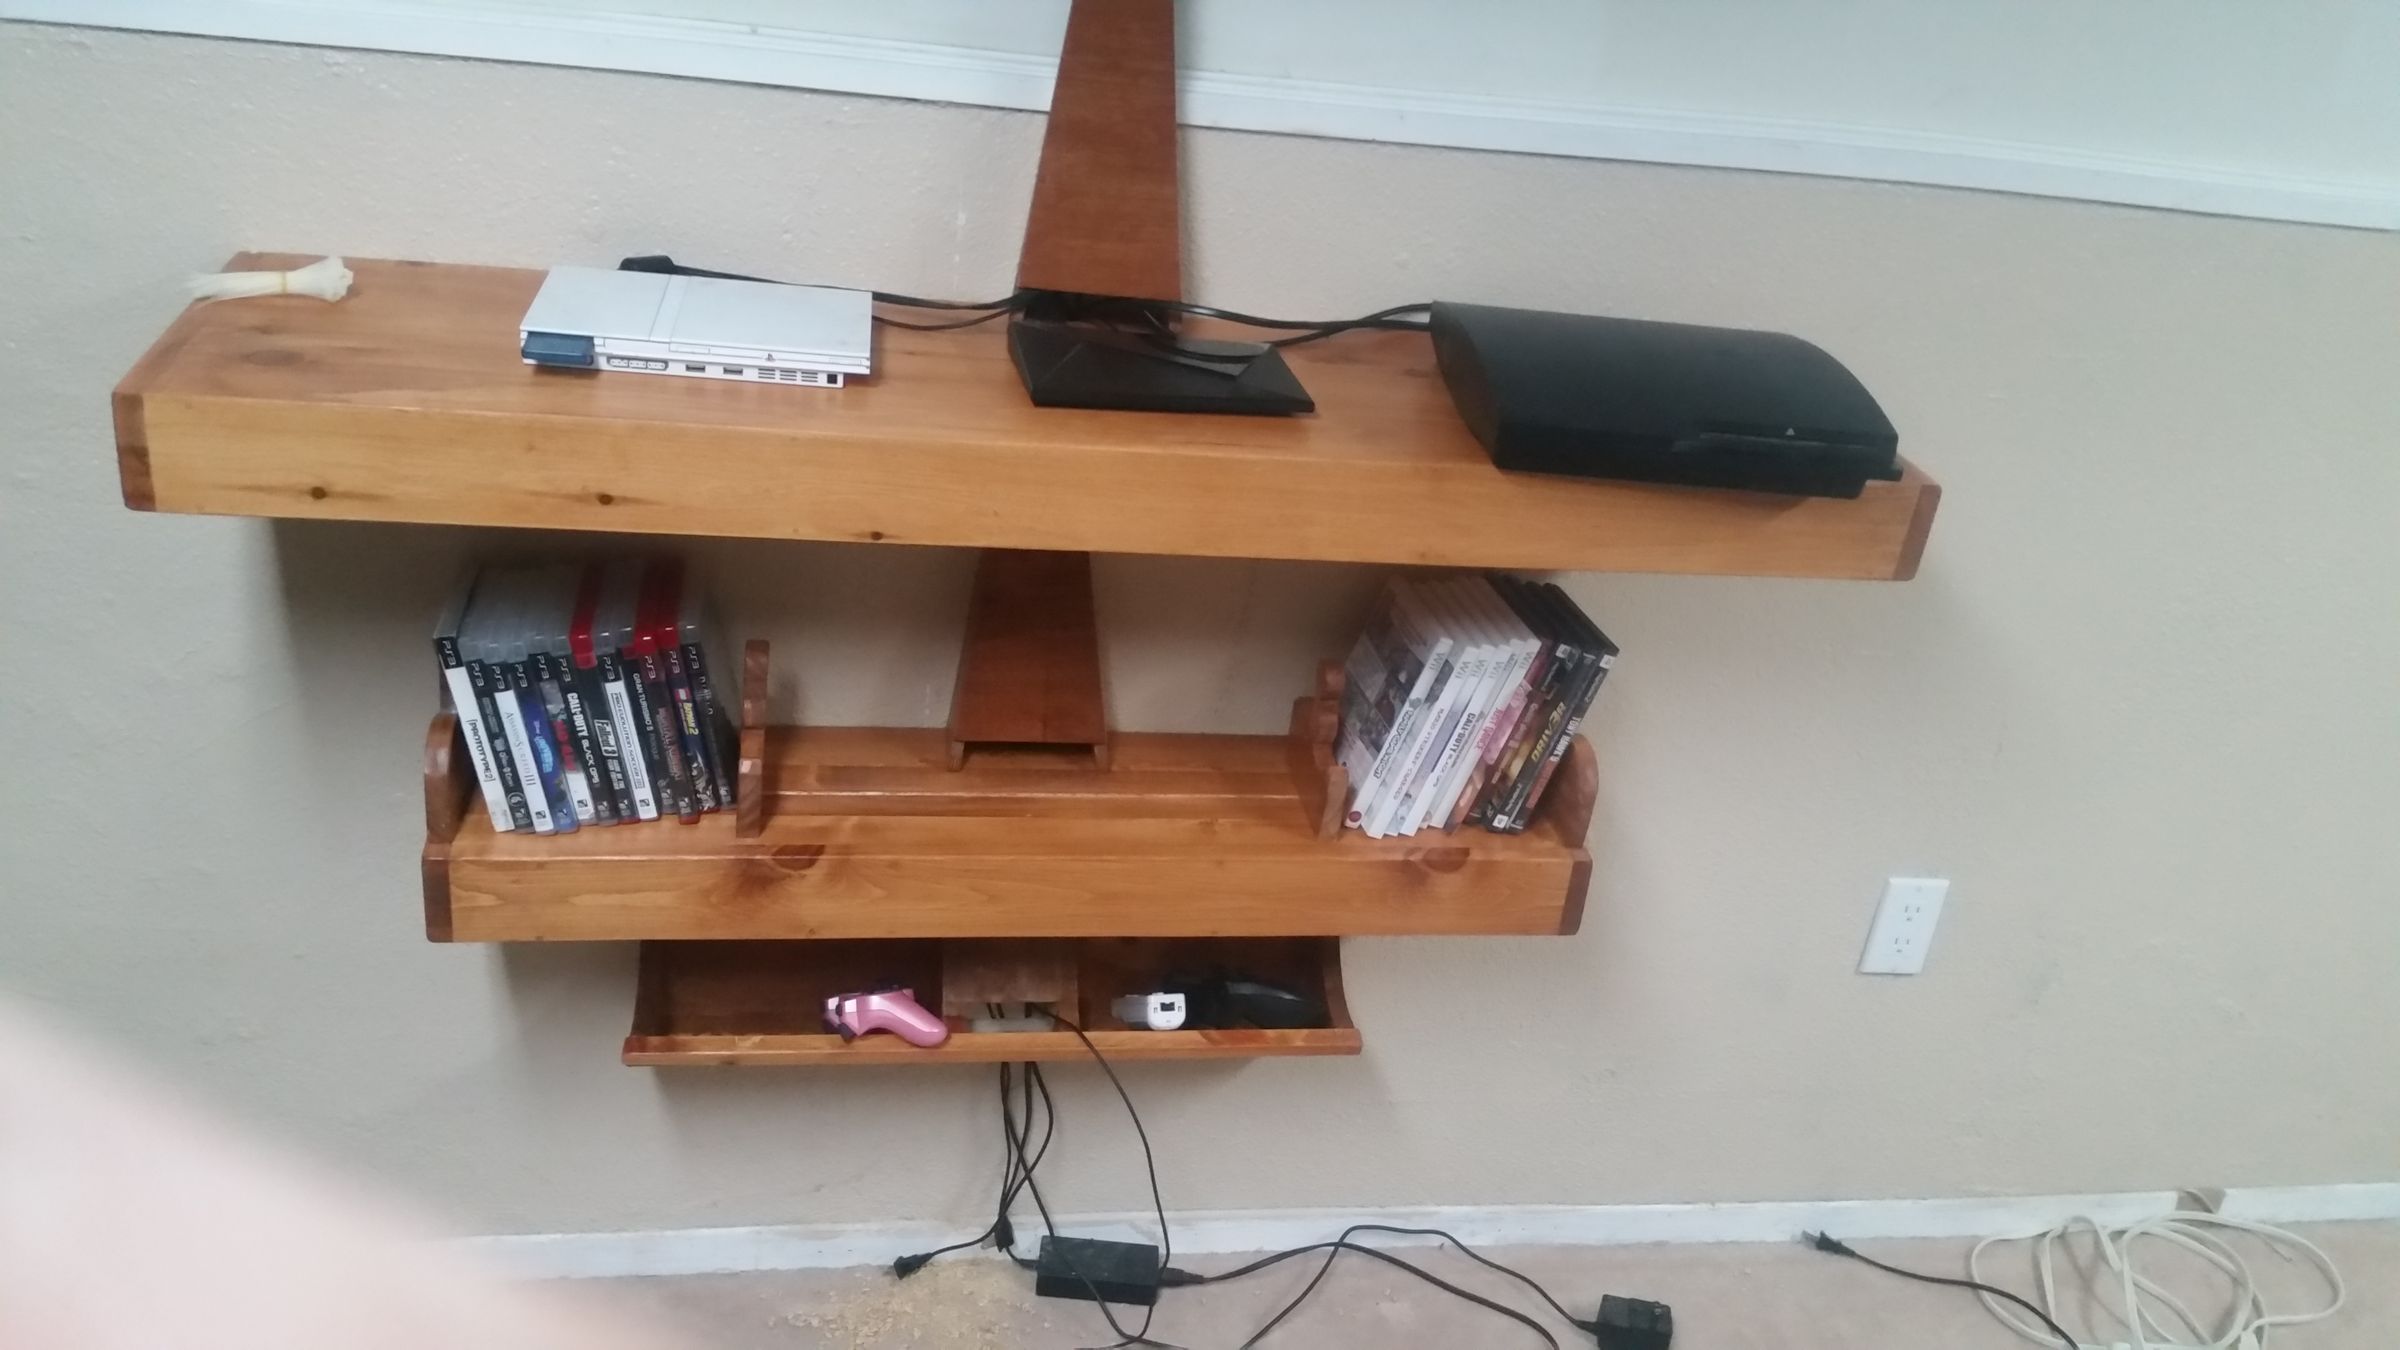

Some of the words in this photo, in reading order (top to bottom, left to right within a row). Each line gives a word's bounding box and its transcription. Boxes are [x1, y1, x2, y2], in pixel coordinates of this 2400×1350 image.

[441, 639, 456, 666] PS3
[668, 650, 680, 674] PS3
[687, 645, 699, 669] PS3
[1429, 649, 1446, 672] Wii
[471, 662, 484, 687] PS3
[492, 665, 505, 689] PS3
[514, 663, 527, 687] PS3
[536, 655, 549, 679] PS3
[558, 657, 570, 682] PS3
[603, 656, 615, 680] PS3
[644, 654, 656, 679] PS3
[1454, 657, 1472, 681] Wii
[1469, 656, 1488, 680] Wii
[1487, 658, 1504, 681] Wii
[566, 691, 581, 713] CALL
[632, 672, 643, 693] GRAN
[638, 694, 651, 725] TURISMO
[572, 713, 588, 738] DUTY
[1460, 710, 1476, 732] CALL
[1526, 699, 1569, 762] DRIV3R
[581, 738, 594, 765] BLACK
[1449, 731, 1465, 754] DUTY
[589, 766, 599, 783] OPS
